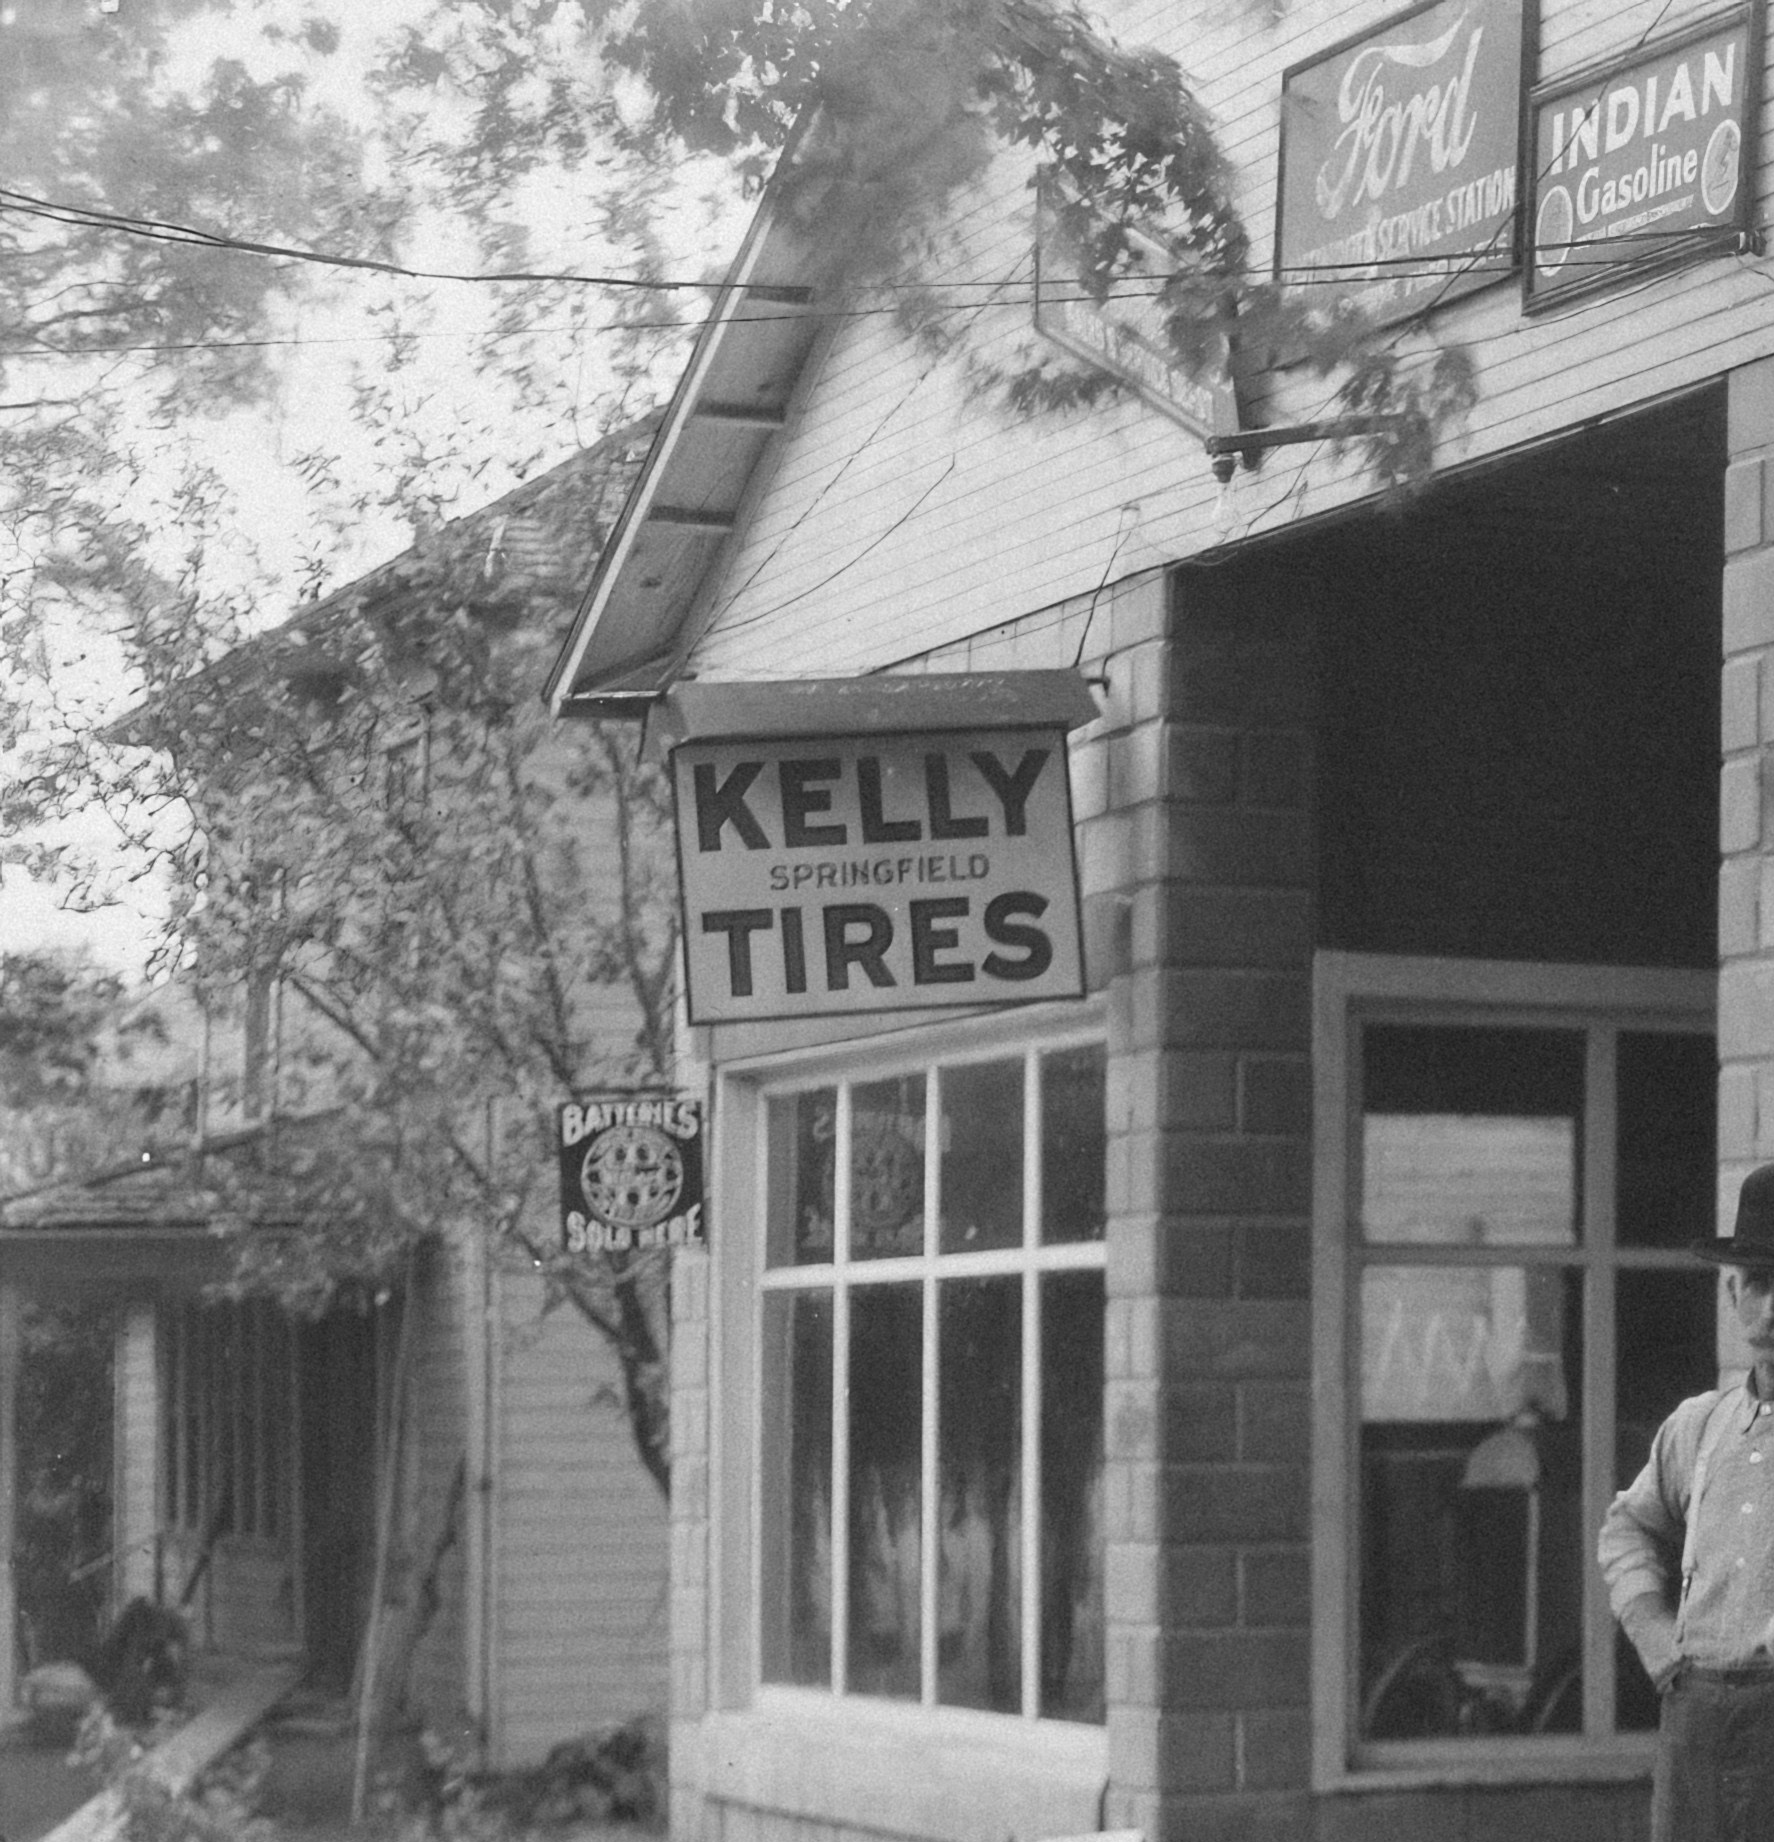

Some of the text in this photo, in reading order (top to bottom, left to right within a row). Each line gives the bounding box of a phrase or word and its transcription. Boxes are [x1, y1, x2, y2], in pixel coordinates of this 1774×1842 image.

[1316, 7, 1484, 219] Ford
[1551, 42, 1735, 176] INDIAN
[1576, 143, 1698, 224] Gasoline
[693, 749, 1051, 852] KELLY
[770, 854, 990, 891] SPRINGFIELD
[701, 891, 1053, 997] TIRES
[563, 1102, 698, 1147] BATTERIES
[567, 1211, 632, 1251] SOLD
